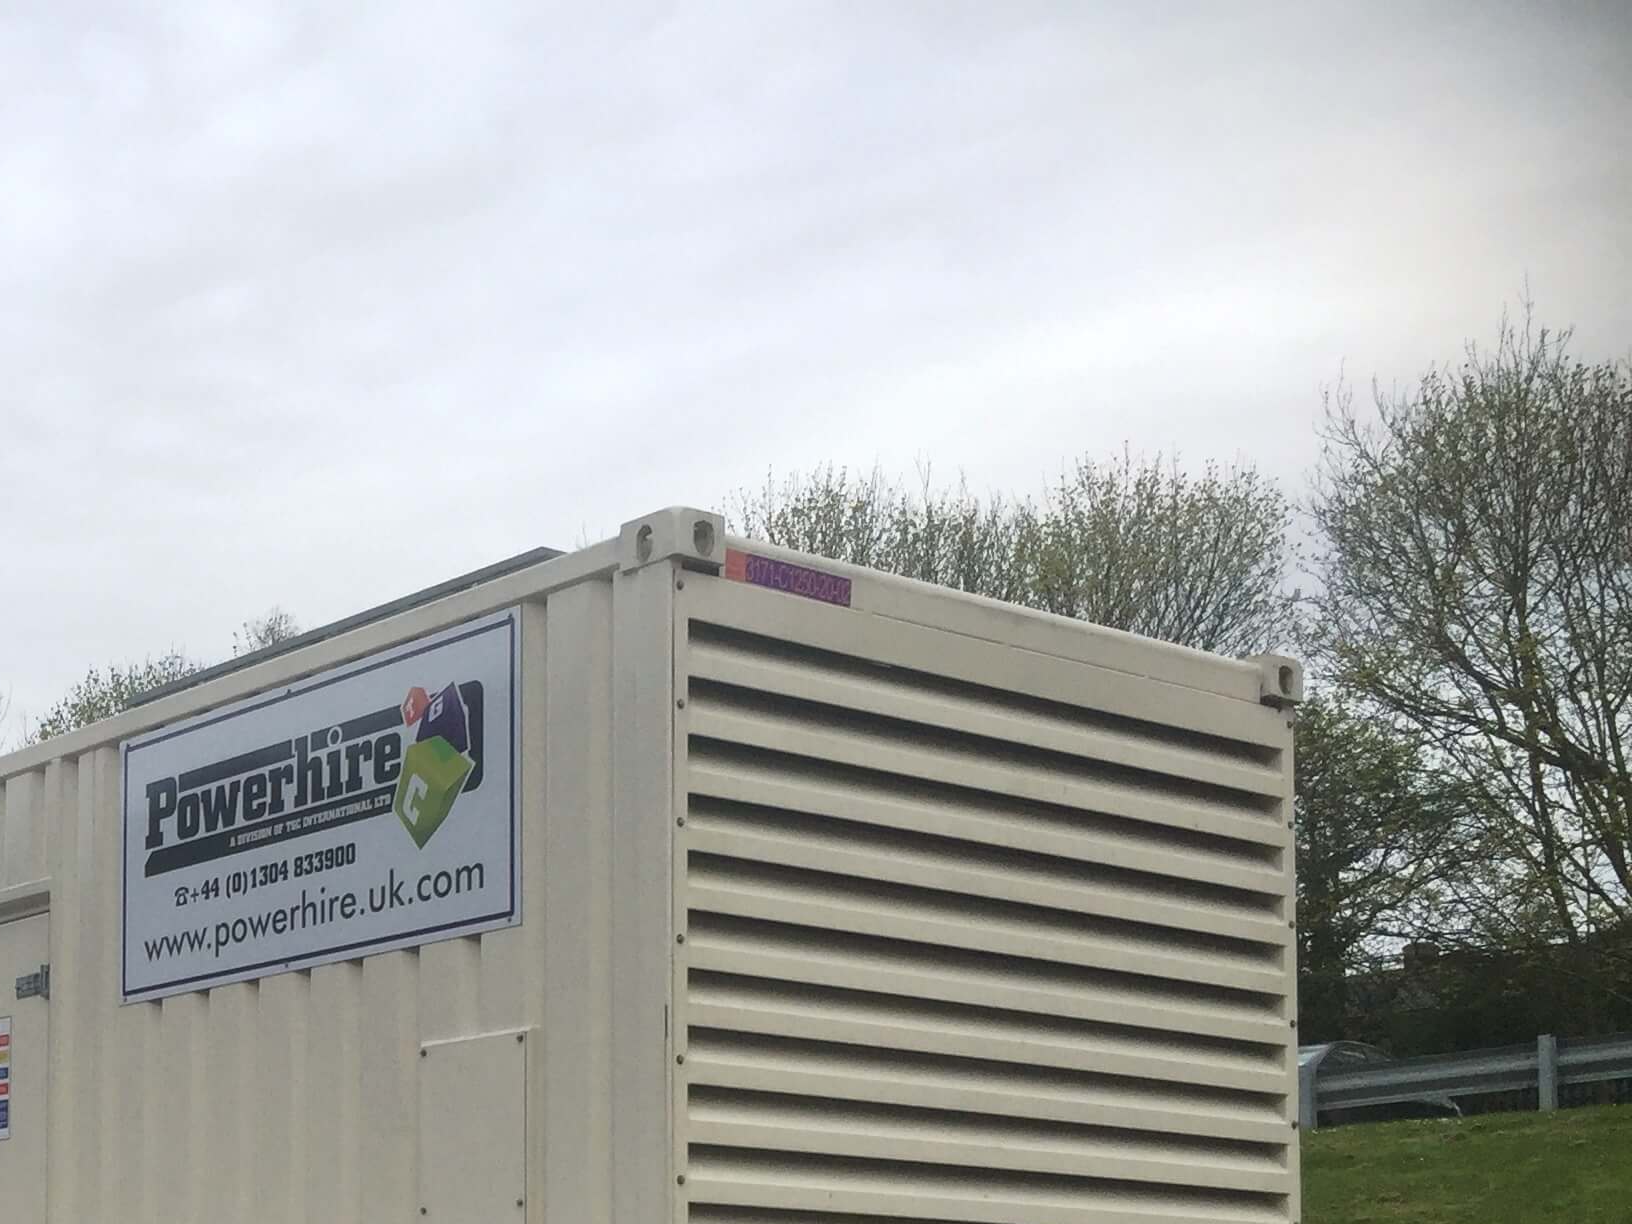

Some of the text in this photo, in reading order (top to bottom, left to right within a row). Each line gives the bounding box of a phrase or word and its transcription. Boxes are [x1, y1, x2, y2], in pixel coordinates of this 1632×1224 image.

[145, 726, 401, 850] Powerhire
[229, 836, 236, 848] A
[237, 829, 272, 846] DIVISION
[273, 825, 284, 836] OF
[303, 800, 373, 828] INTERNATIONAL
[374, 793, 392, 811] LTD
[226, 859, 289, 898] (0)1304
[294, 842, 357, 880] 833900
[144, 861, 485, 961] www.powerhire.uk.com
